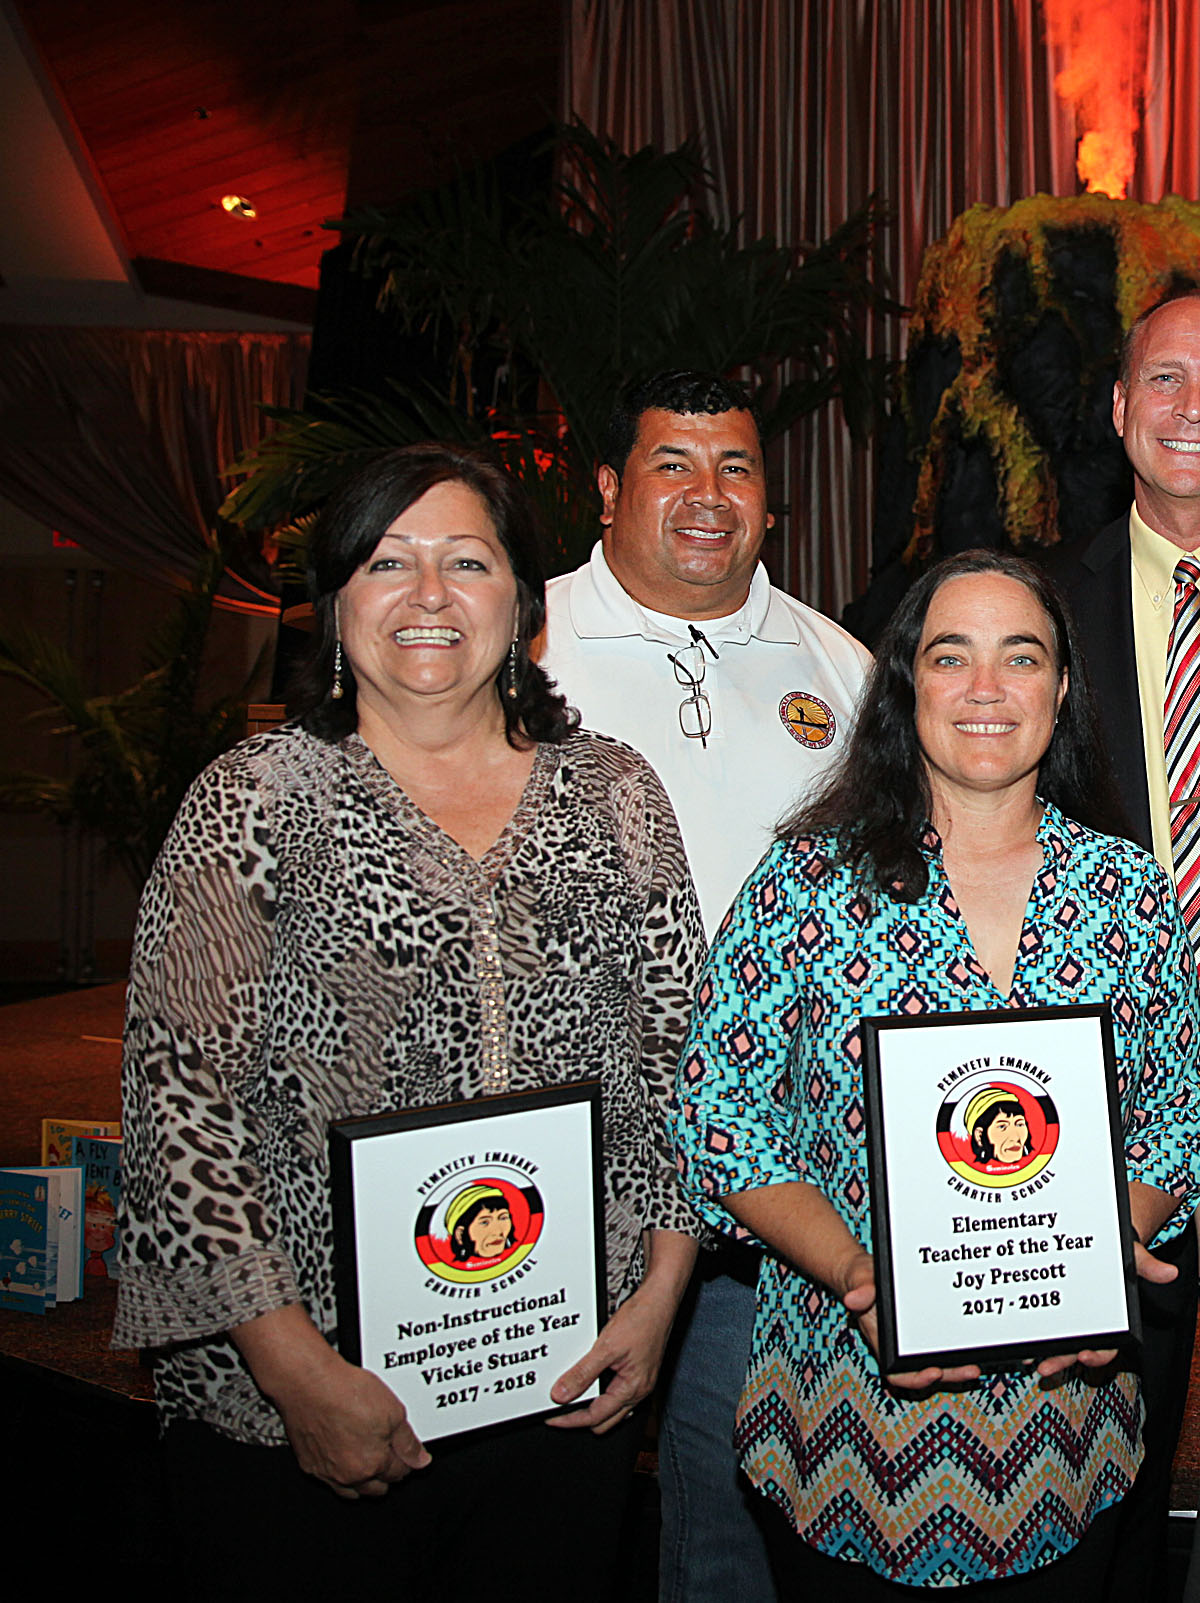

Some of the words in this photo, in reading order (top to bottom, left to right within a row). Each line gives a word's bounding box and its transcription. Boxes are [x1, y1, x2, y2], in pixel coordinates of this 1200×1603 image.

[938, 1056, 991, 1091] PEMAYETV
[1000, 1056, 1052, 1085] EMAHAKV
[75, 1141, 85, 1157] A
[90, 1142, 108, 1160] FLY
[86, 1163, 109, 1178] ENT
[418, 1155, 475, 1195] PEMAYETV
[948, 1175, 1002, 1203] CHARTER
[1011, 1170, 1055, 1201] SCHOOL
[952, 1211, 1057, 1234] Elementary
[919, 1242, 991, 1264] Teacher
[996, 1240, 1015, 1256] of
[1019, 1238, 1049, 1254] the
[1053, 1234, 1094, 1250] Year
[424, 1277, 481, 1299] CHARTER
[491, 1259, 537, 1293] SCHOOL
[953, 1271, 985, 1289] Joy
[991, 1264, 1066, 1284] Prescott
[397, 1288, 567, 1341] Non-Instructional
[962, 1298, 1003, 1315] 2017
[1019, 1291, 1061, 1308] 2018
[383, 1335, 477, 1370] Employee
[481, 1327, 501, 1346] of
[504, 1323, 535, 1341] the
[540, 1312, 580, 1330] Year
[421, 1359, 483, 1385] Vickie
[488, 1343, 549, 1370] Stuart
[436, 1386, 478, 1408] 2017
[494, 1371, 536, 1394] 2018
